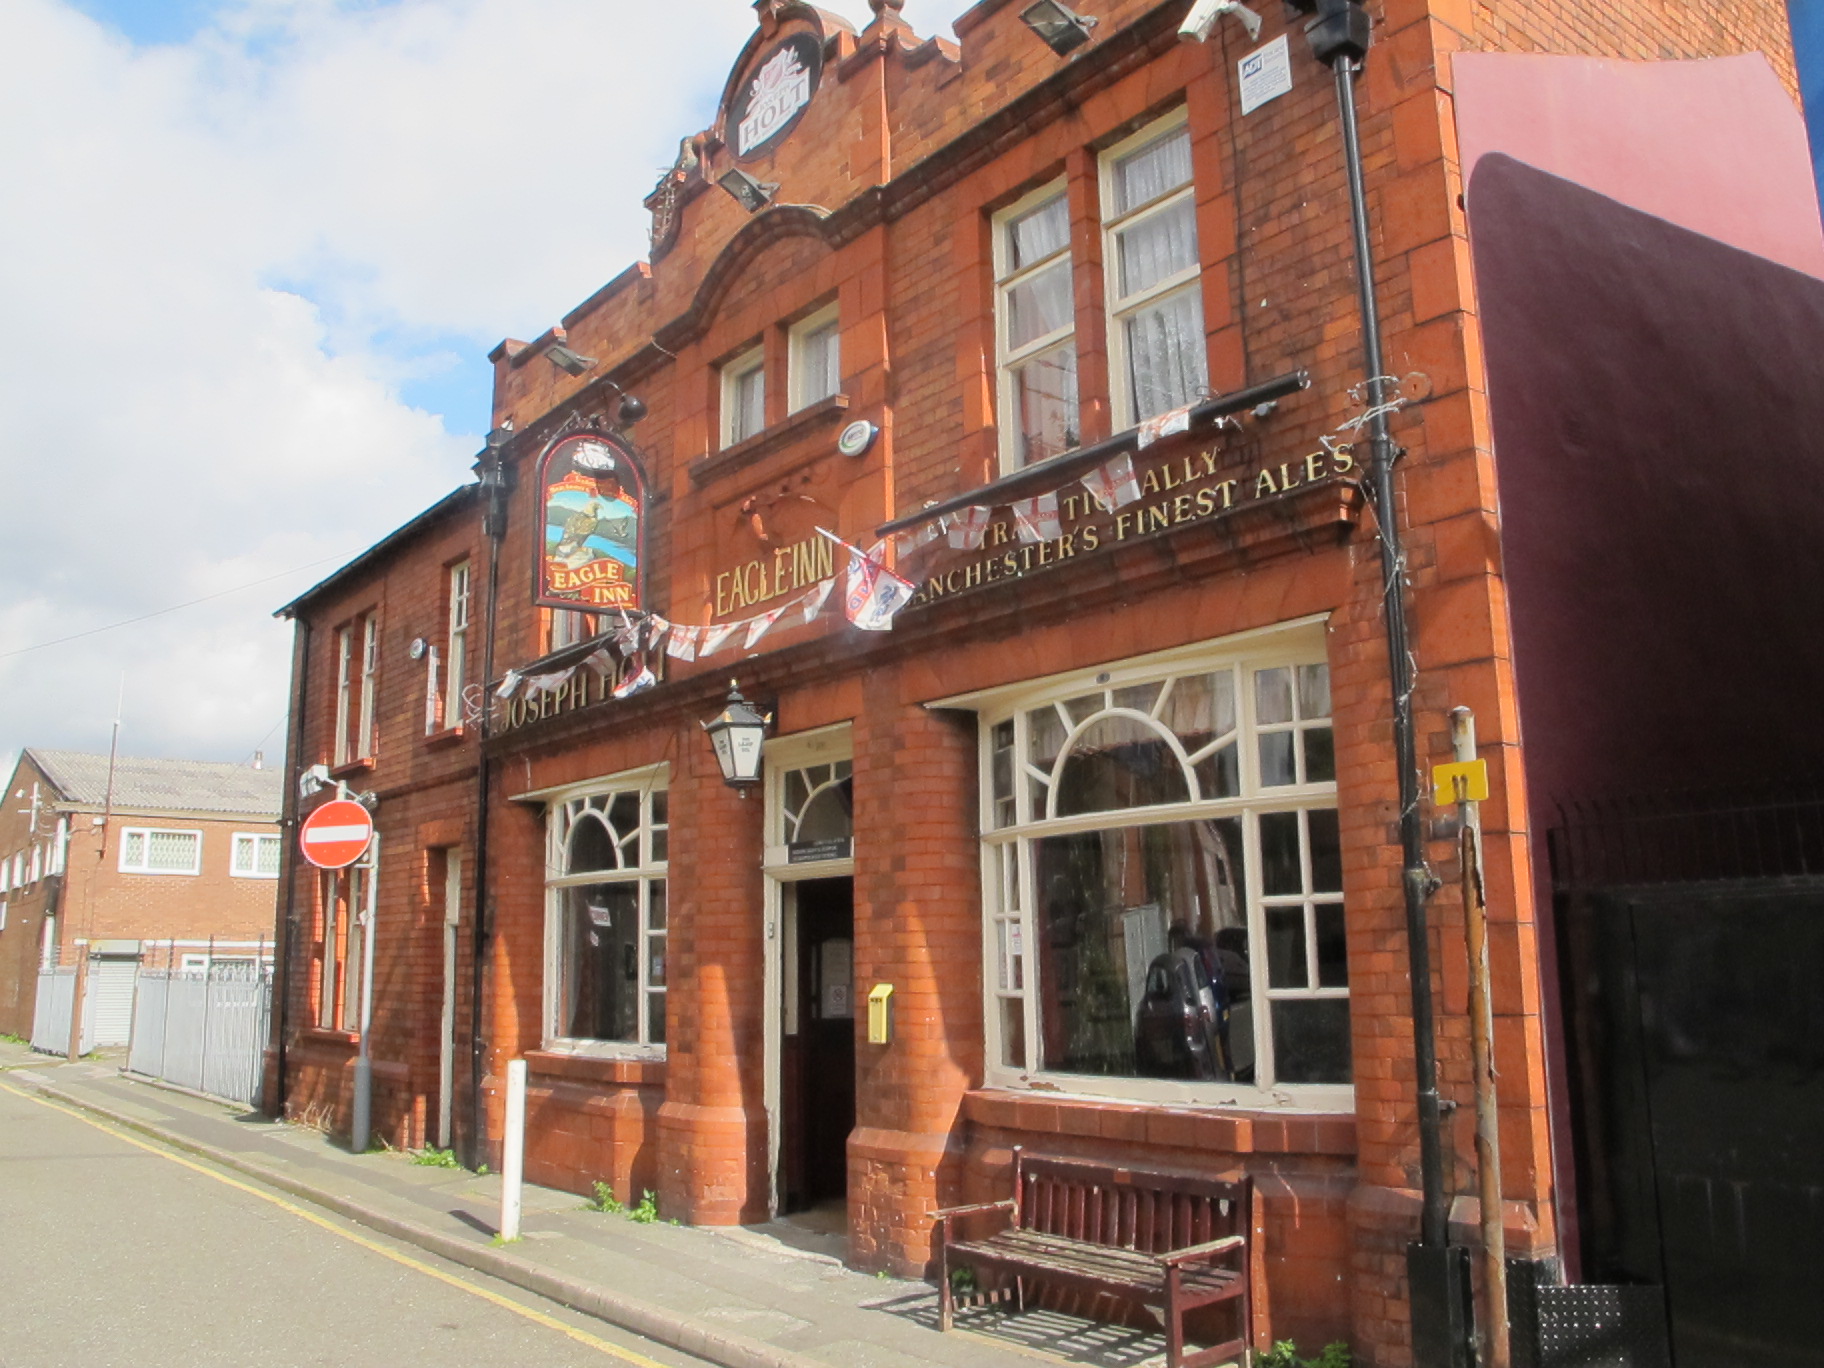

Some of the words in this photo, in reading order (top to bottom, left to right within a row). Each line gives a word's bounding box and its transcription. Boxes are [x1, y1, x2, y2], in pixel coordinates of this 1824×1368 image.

[744, 77, 806, 144] HOLT
[1116, 479, 1237, 541] FINEST
[1255, 443, 1354, 498] ALES
[553, 562, 620, 589] EAGLE
[593, 587, 630, 603] INN
[717, 546, 791, 617] EAGLE
[792, 533, 834, 589] INN
[501, 671, 588, 733] JOSEPH
